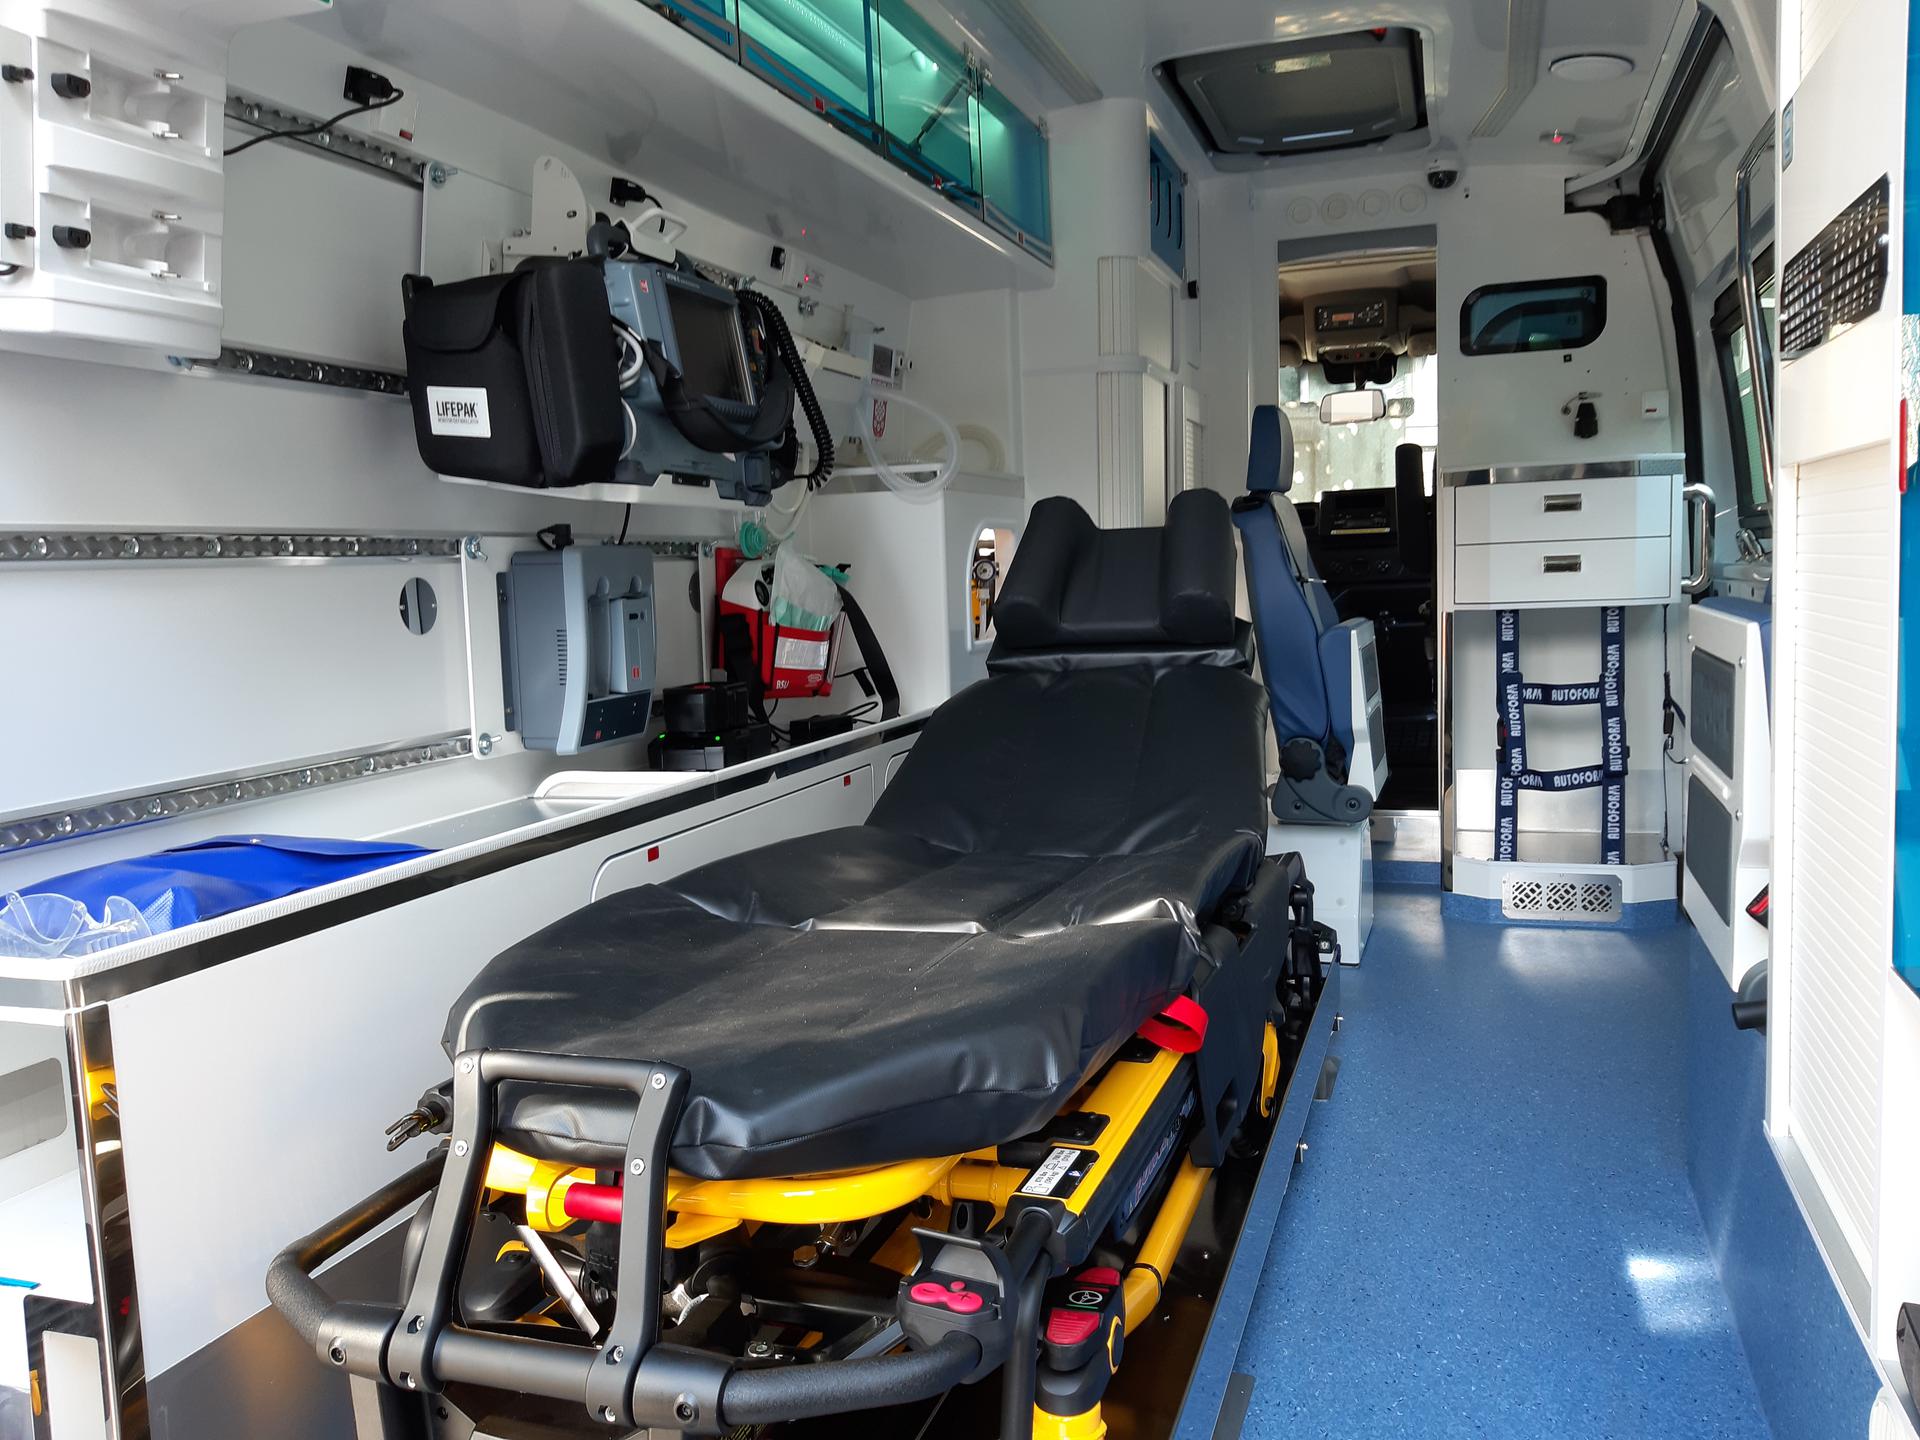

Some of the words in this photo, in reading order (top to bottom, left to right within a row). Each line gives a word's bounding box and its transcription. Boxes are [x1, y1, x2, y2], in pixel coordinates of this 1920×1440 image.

[436, 401, 478, 418] LIFEPAK
[1506, 683, 1521, 736] AUTOFORM
[1607, 717, 1622, 771] AUTOFORM
[1607, 785, 1620, 840] AUTOFORM
